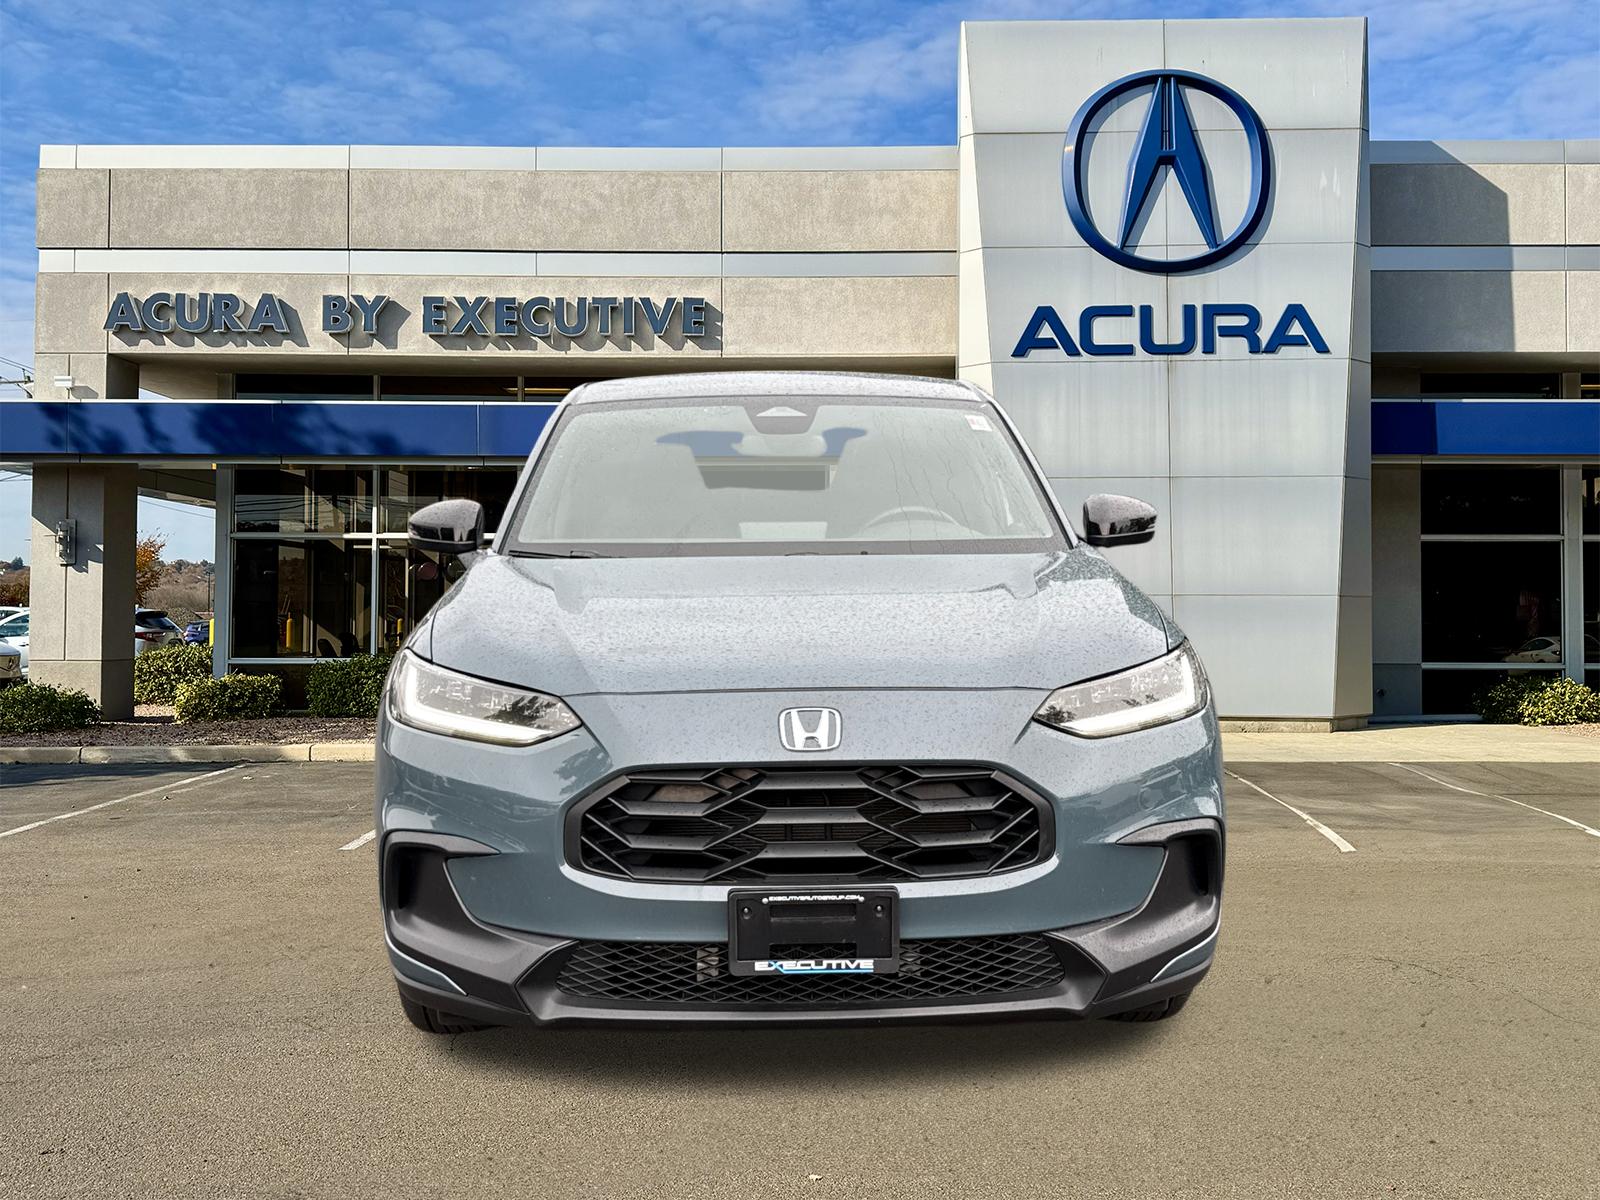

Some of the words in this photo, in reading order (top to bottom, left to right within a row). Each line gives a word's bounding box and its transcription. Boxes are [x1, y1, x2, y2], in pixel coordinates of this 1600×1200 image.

[104, 290, 290, 334] ACURA
[322, 294, 388, 335] BY
[422, 296, 708, 338] EXECUTIVE
[1011, 303, 1331, 357] ACURA
[754, 959, 874, 973] EXECUTIVE
